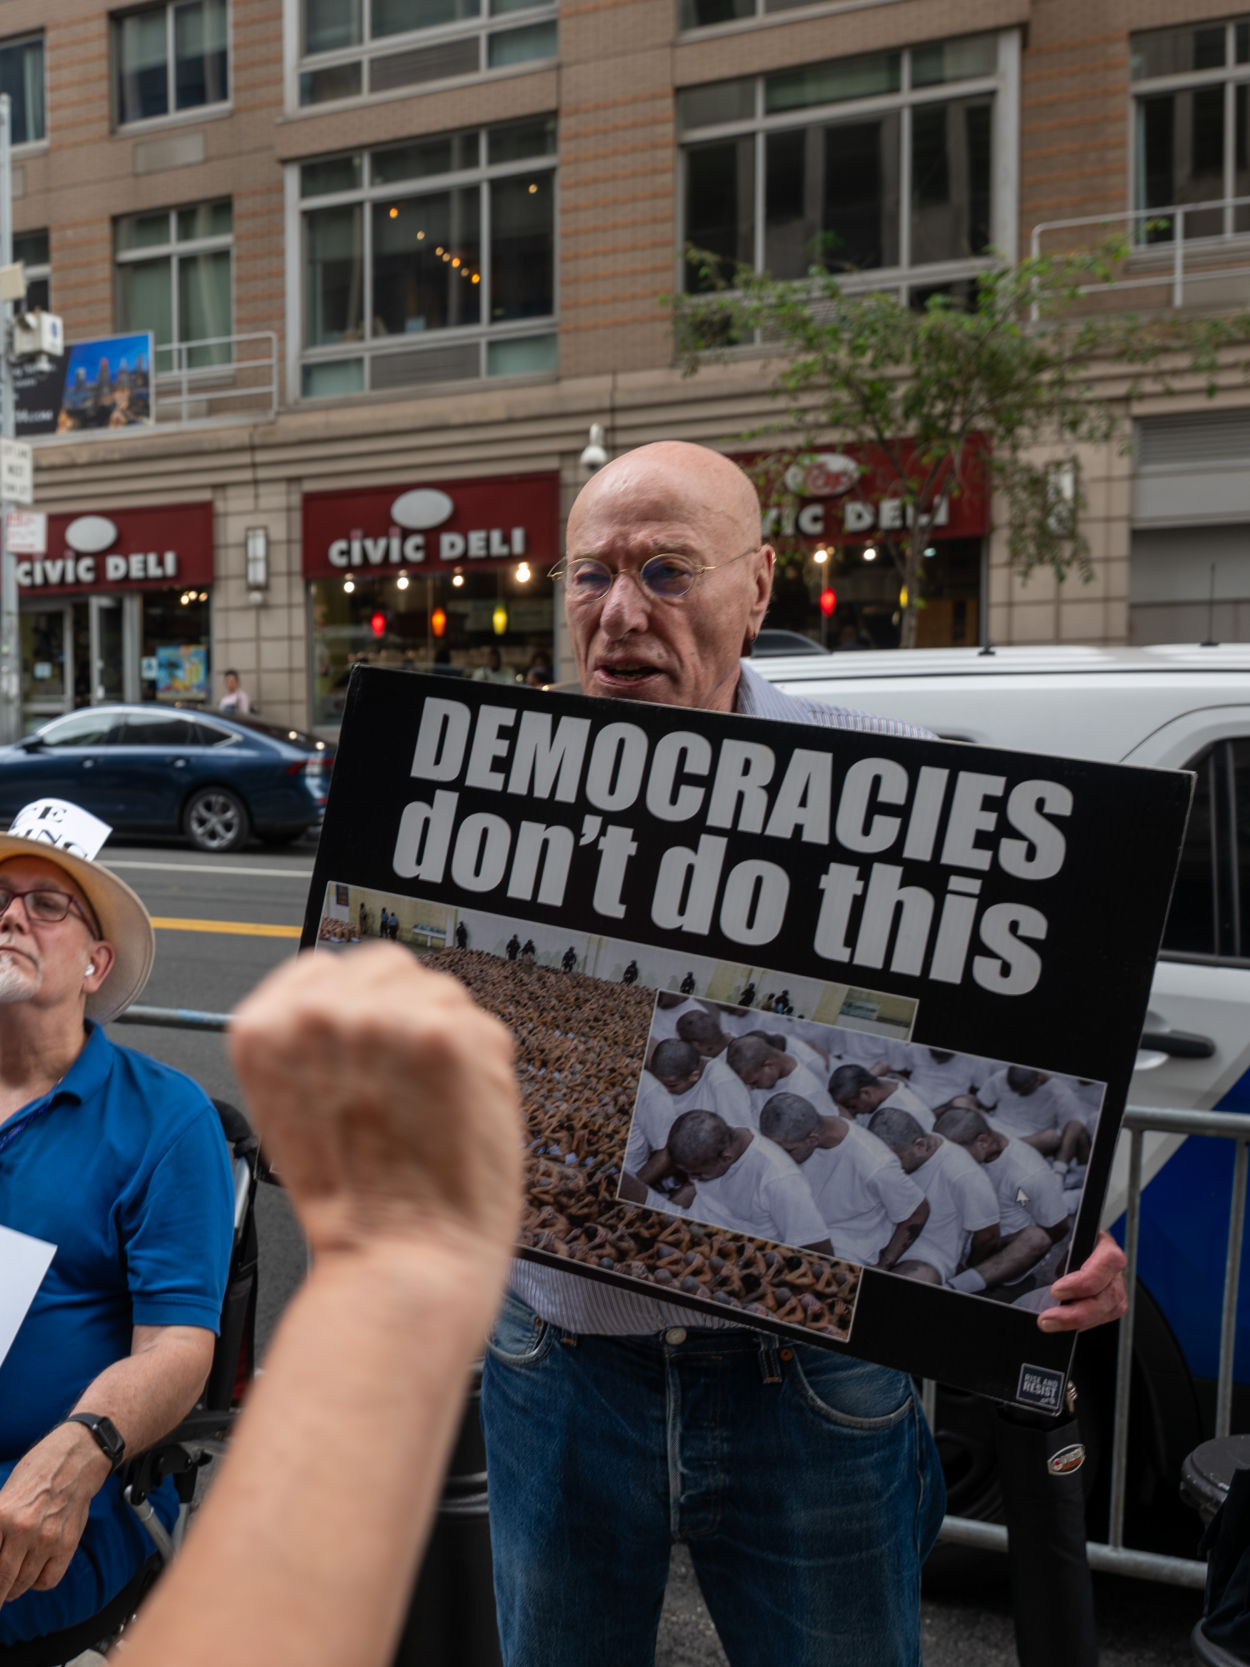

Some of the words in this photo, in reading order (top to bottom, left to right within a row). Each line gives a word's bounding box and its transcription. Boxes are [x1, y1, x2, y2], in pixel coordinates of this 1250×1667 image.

[440, 527, 526, 561] DELI
[105, 551, 177, 581] DELI
[410, 696, 1075, 881] DEMOCRACIES
[9, 805, 68, 831] CE
[651, 834, 791, 946] do
[813, 862, 1049, 997] this
[1022, 1381, 1058, 1397] RESIST
[1024, 1373, 1042, 1384] RISE
[1042, 1378, 1059, 1388] AND
